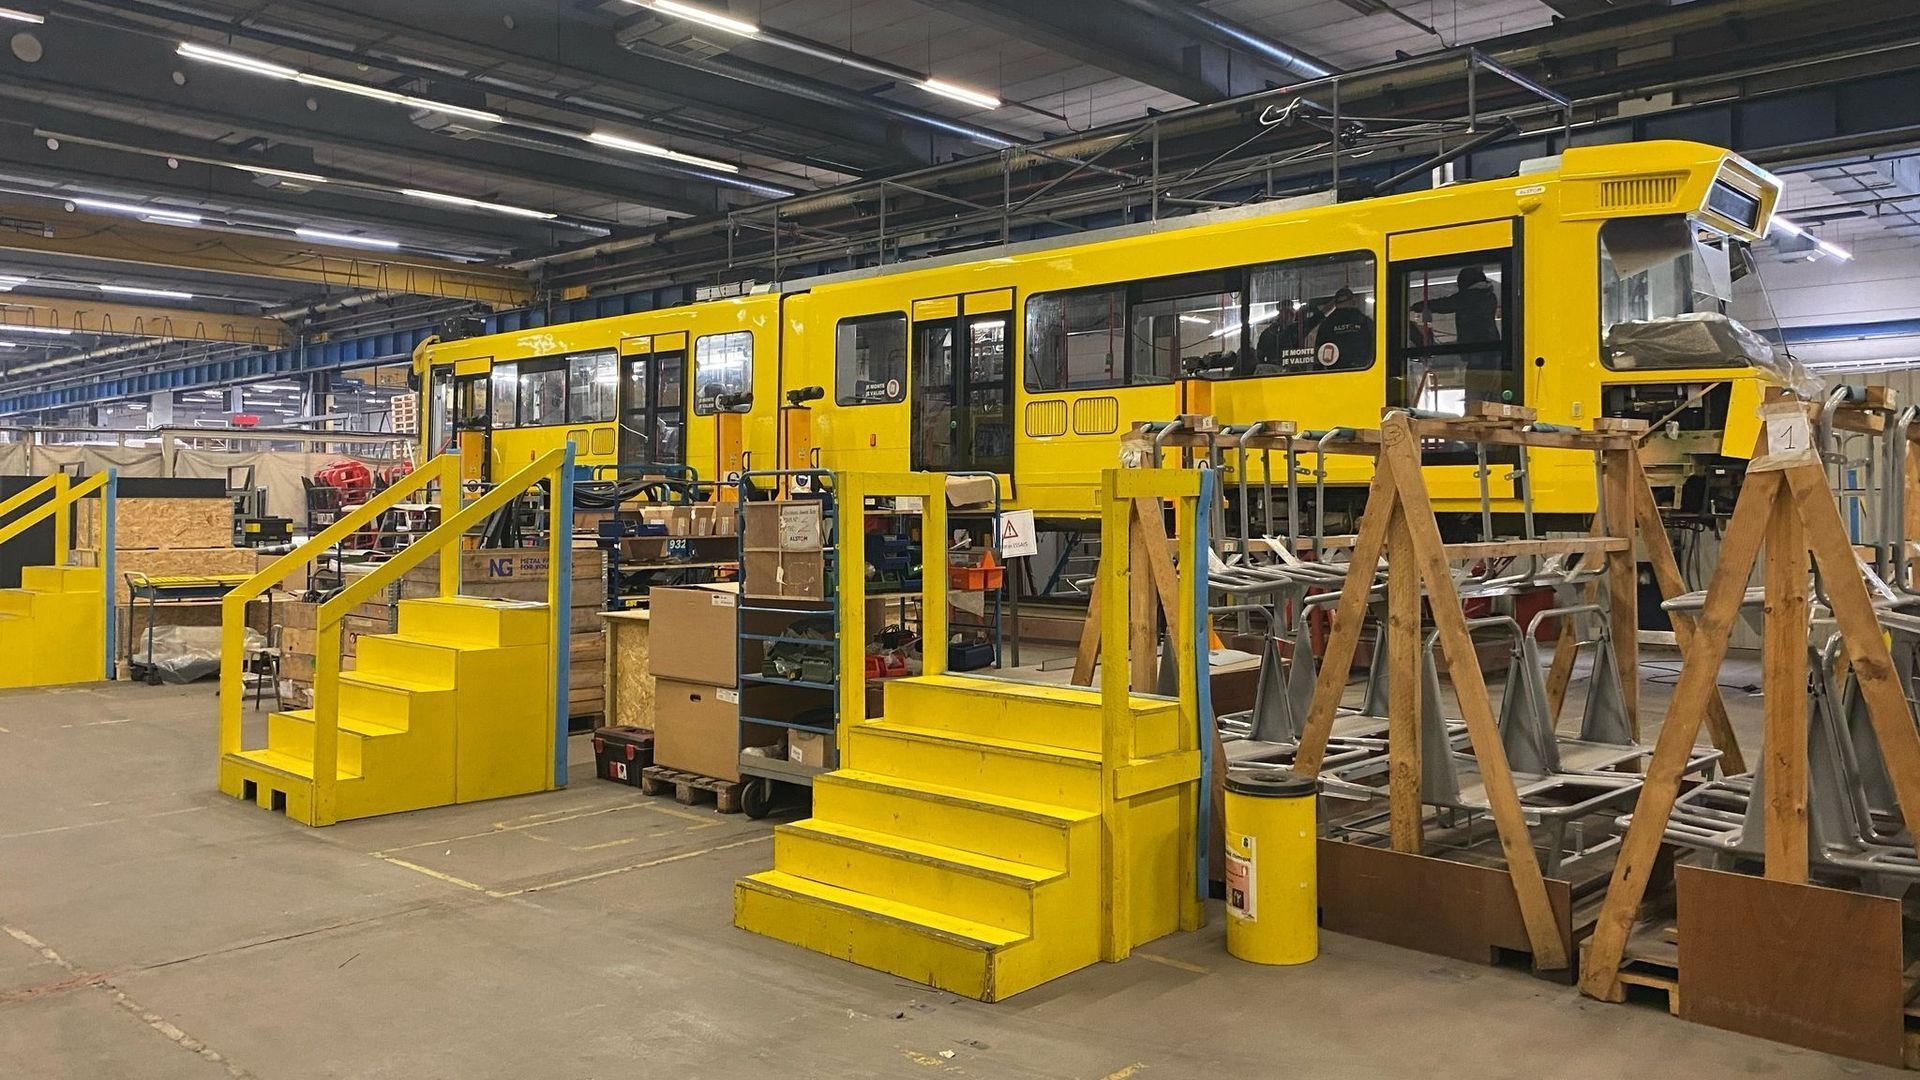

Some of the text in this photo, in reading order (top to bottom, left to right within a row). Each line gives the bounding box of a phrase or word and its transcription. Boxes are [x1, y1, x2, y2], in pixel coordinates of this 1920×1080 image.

[1282, 348, 1315, 358] JE MONTE
[1290, 356, 1315, 365] VALIDE
[1780, 425, 1796, 450] 1
[669, 539, 687, 549] 932
[489, 558, 514, 578] NG
